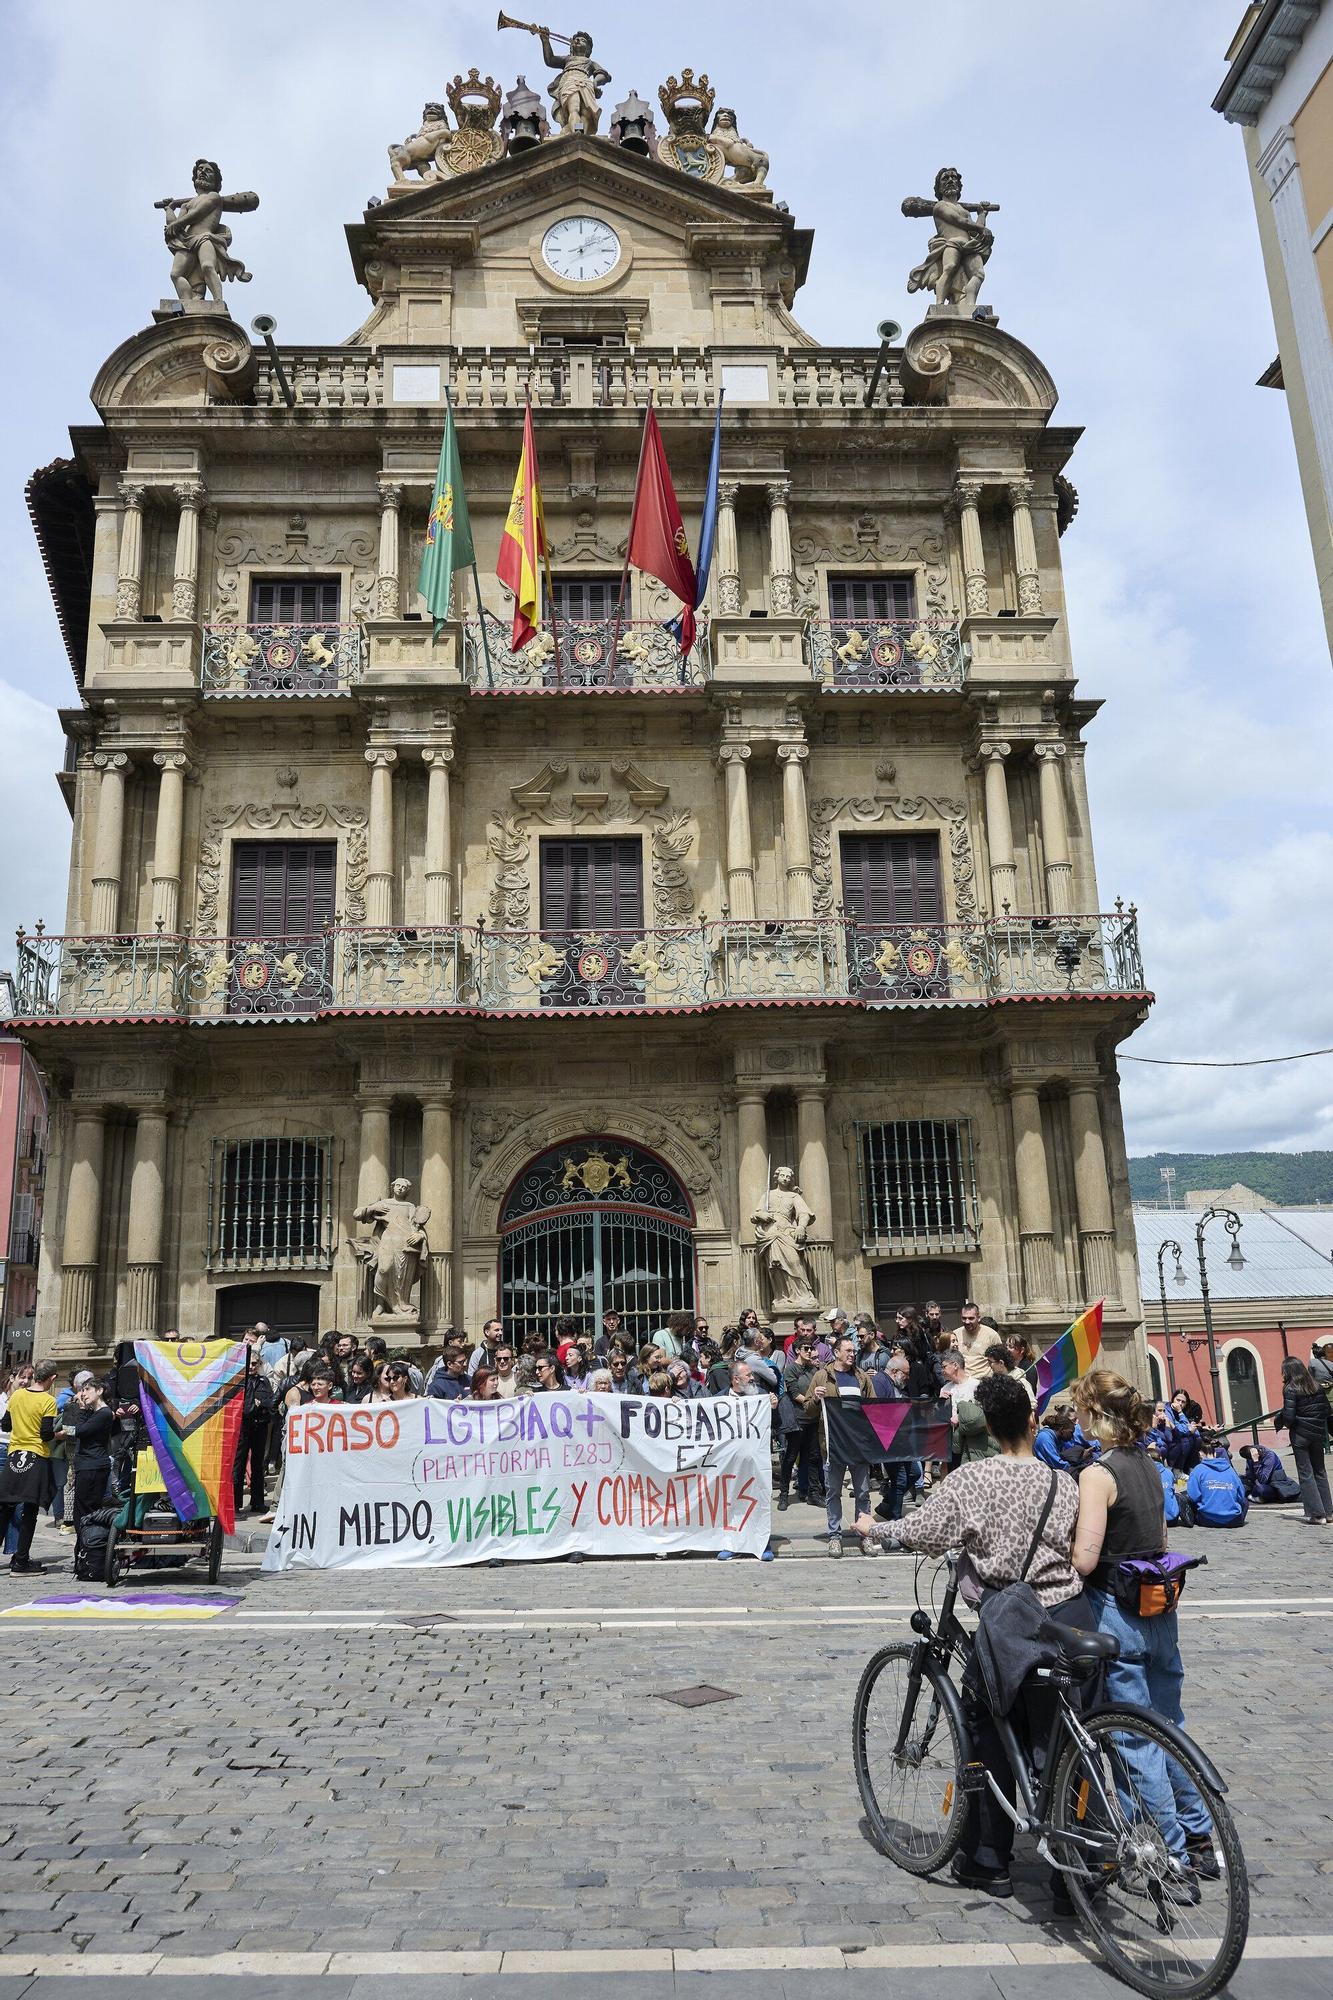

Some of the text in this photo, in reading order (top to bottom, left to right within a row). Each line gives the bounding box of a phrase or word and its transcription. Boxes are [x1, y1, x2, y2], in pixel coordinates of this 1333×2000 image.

[12, 1330, 32, 1338] 18 °C
[288, 1409, 400, 1454] ERASO
[676, 1443, 718, 1473] EZ
[339, 1499, 435, 1547] MIEDO,
[446, 1486, 562, 1543] VISIBLES
[570, 1480, 588, 1528] Y
[597, 1473, 759, 1532] COMBATIVES
